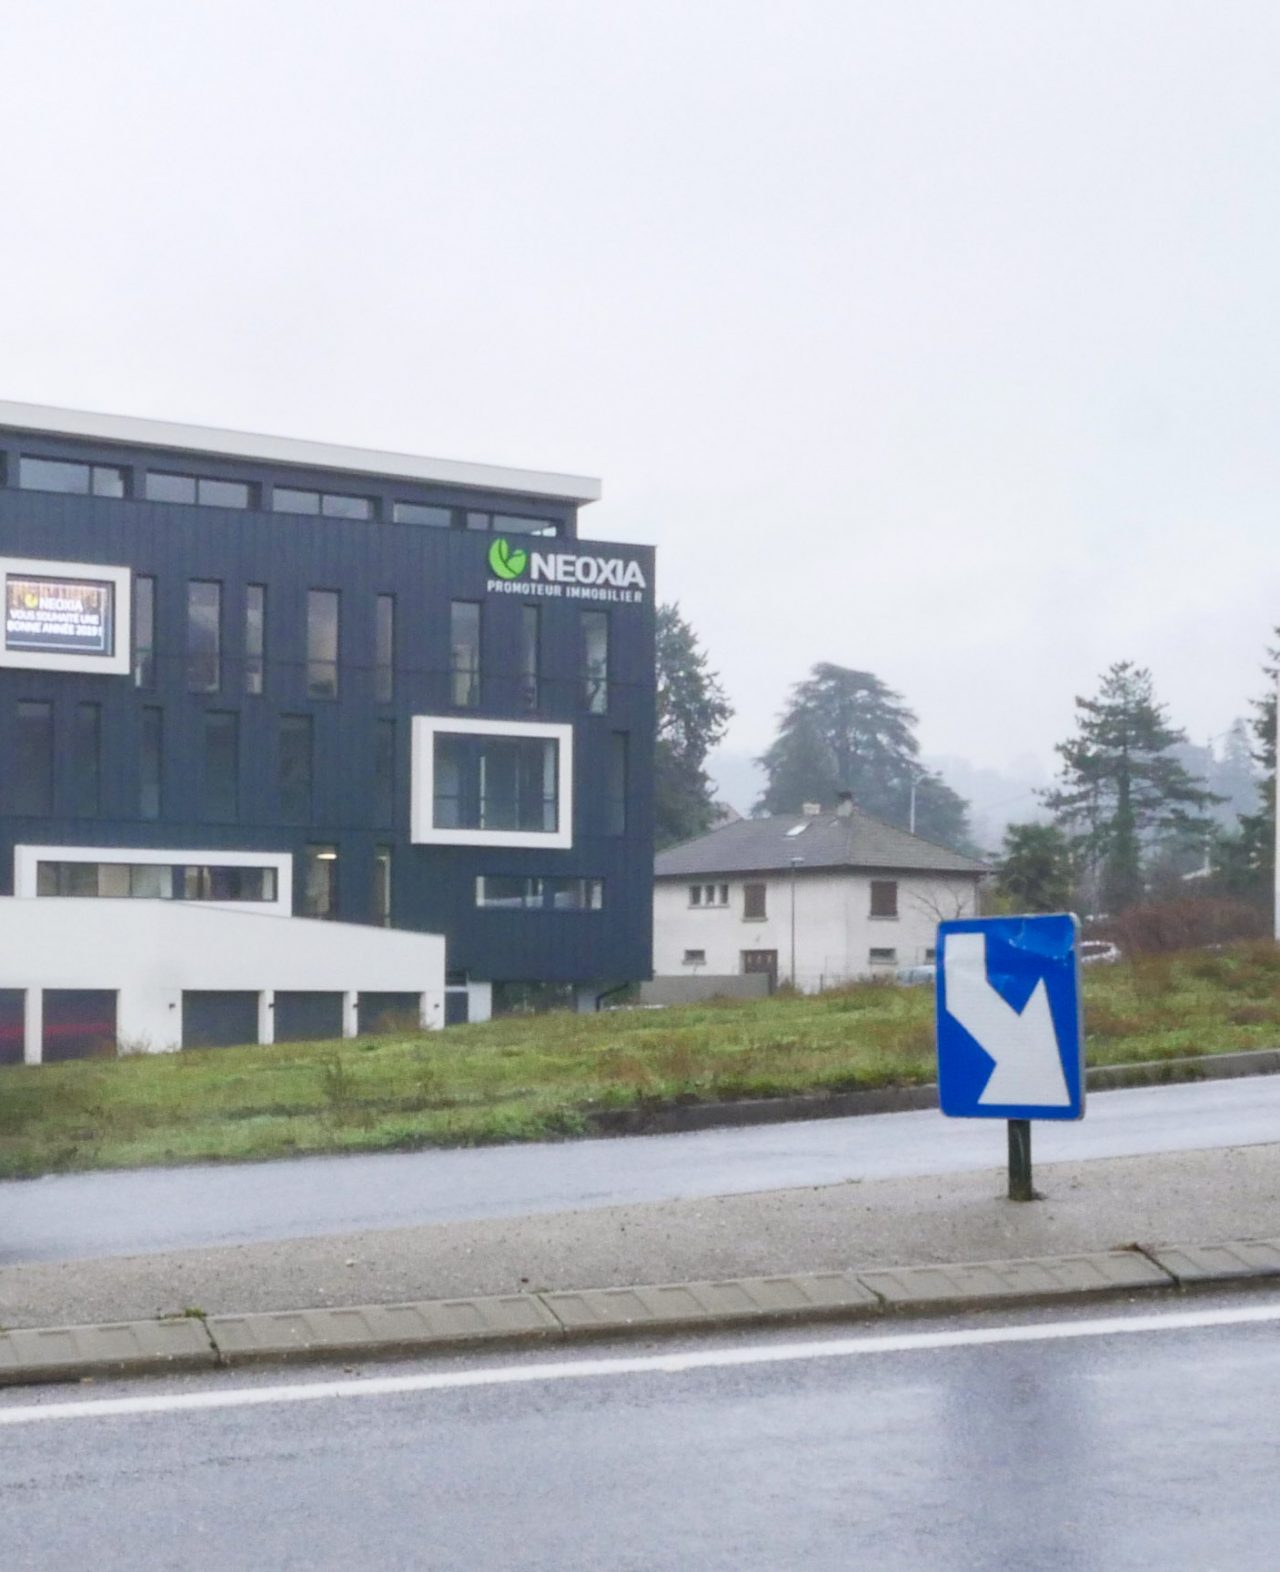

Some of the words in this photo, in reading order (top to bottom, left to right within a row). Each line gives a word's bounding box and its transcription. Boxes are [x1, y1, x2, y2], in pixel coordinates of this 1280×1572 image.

[530, 552, 646, 588] NEOXIA
[487, 580, 562, 597] PROMOTEUR
[566, 586, 643, 603] IMMOBILIER
[39, 597, 83, 613] NEOXIA
[10, 609, 35, 621] VOUS
[36, 610, 79, 625] SOUHAITE
[80, 613, 100, 625] UNE
[7, 620, 41, 633] BONNE
